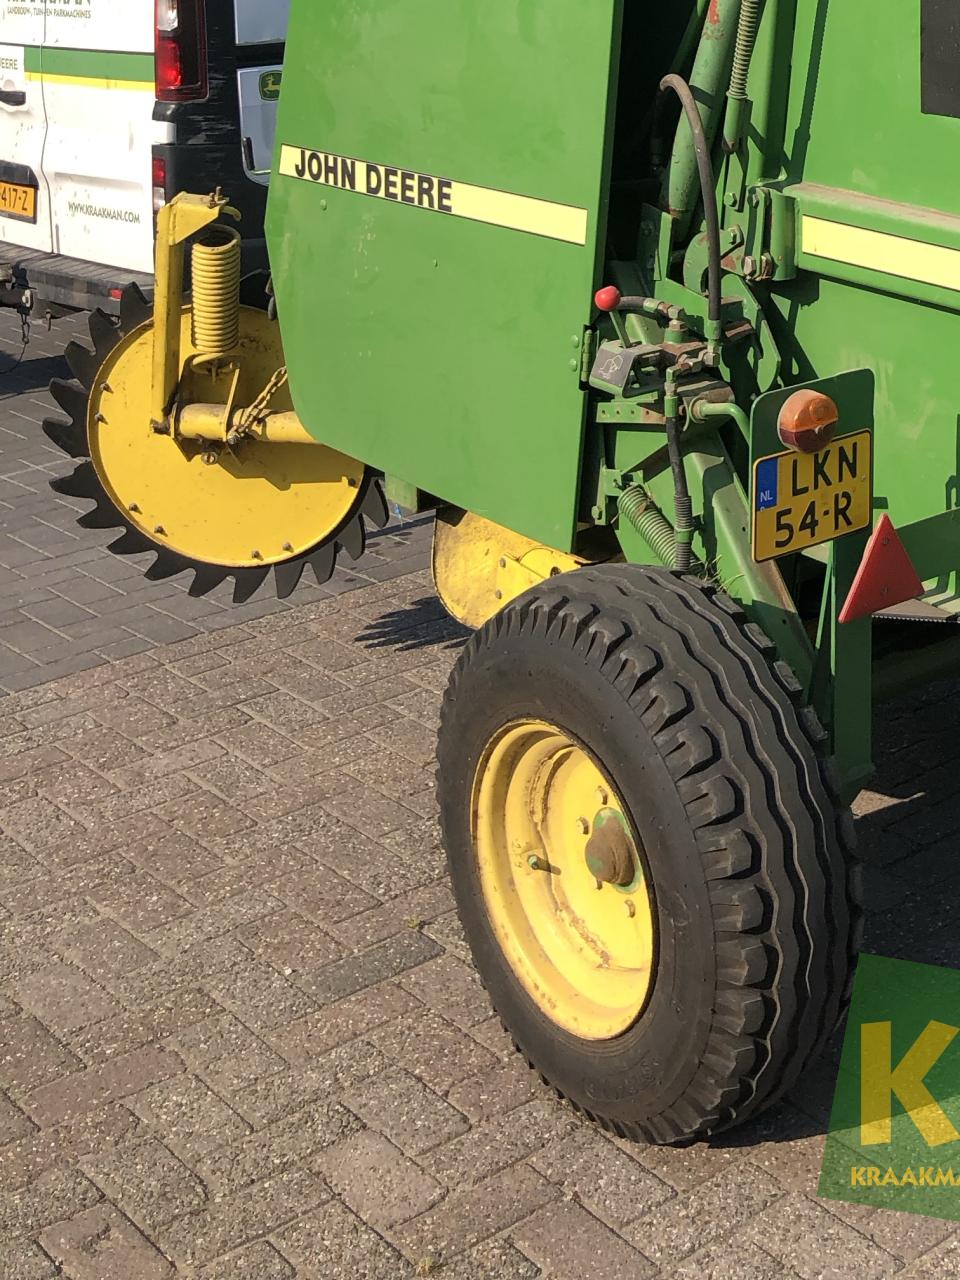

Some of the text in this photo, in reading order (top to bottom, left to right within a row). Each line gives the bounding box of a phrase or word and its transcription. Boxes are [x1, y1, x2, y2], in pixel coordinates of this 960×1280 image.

[54, 9, 92, 19] PARKMACHINES
[0, 57, 18, 70] EERE
[295, 149, 452, 213] JOHN DEERE
[68, 201, 140, 223] WWW.KRAAKMAN.COM
[791, 442, 858, 497] LKN
[760, 489, 773, 503] NL
[775, 491, 853, 548] 54-R
